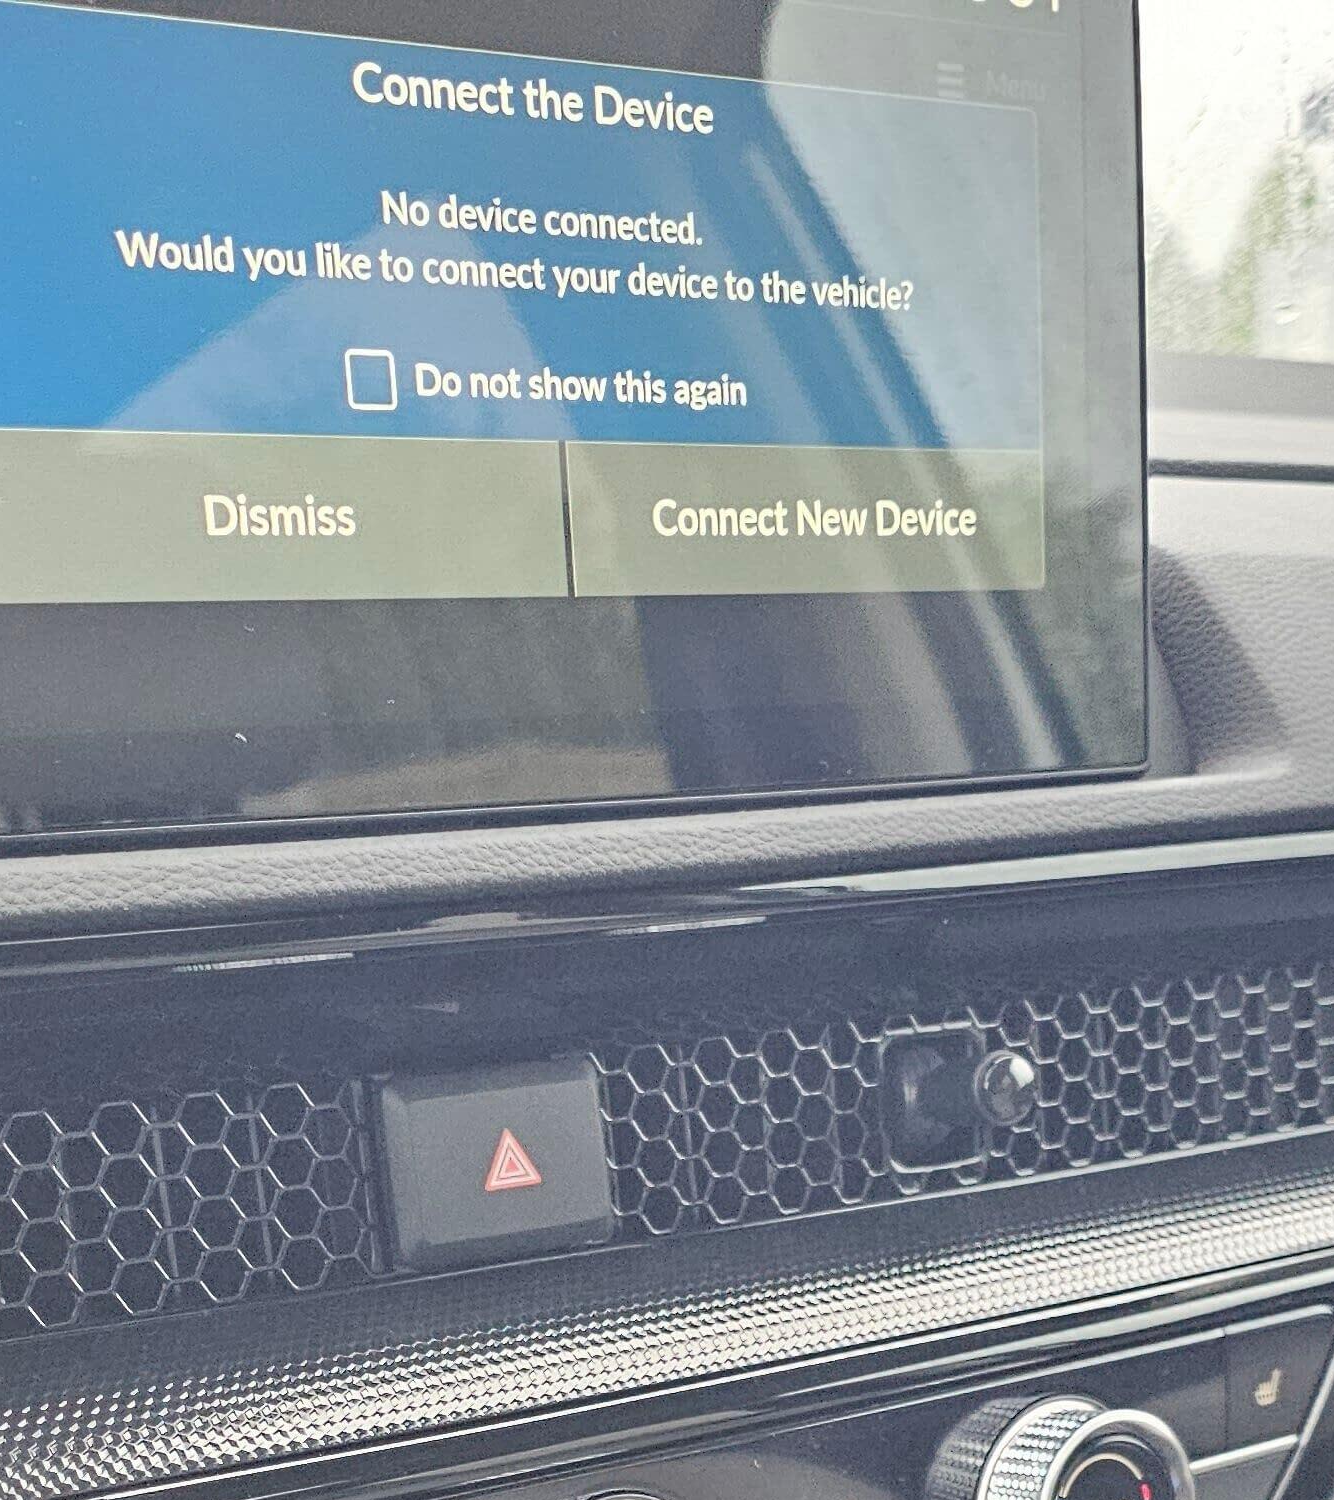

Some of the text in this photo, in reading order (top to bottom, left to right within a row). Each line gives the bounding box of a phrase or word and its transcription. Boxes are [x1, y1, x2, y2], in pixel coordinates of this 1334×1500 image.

[352, 62, 714, 134] Connect the Device
[381, 190, 702, 245] No device connected.
[114, 229, 915, 311] Would you like to connect your device to the vehicle?
[415, 363, 748, 411] Do not show this again
[203, 493, 356, 536] Dismiss
[652, 498, 977, 536] Connect New Device
